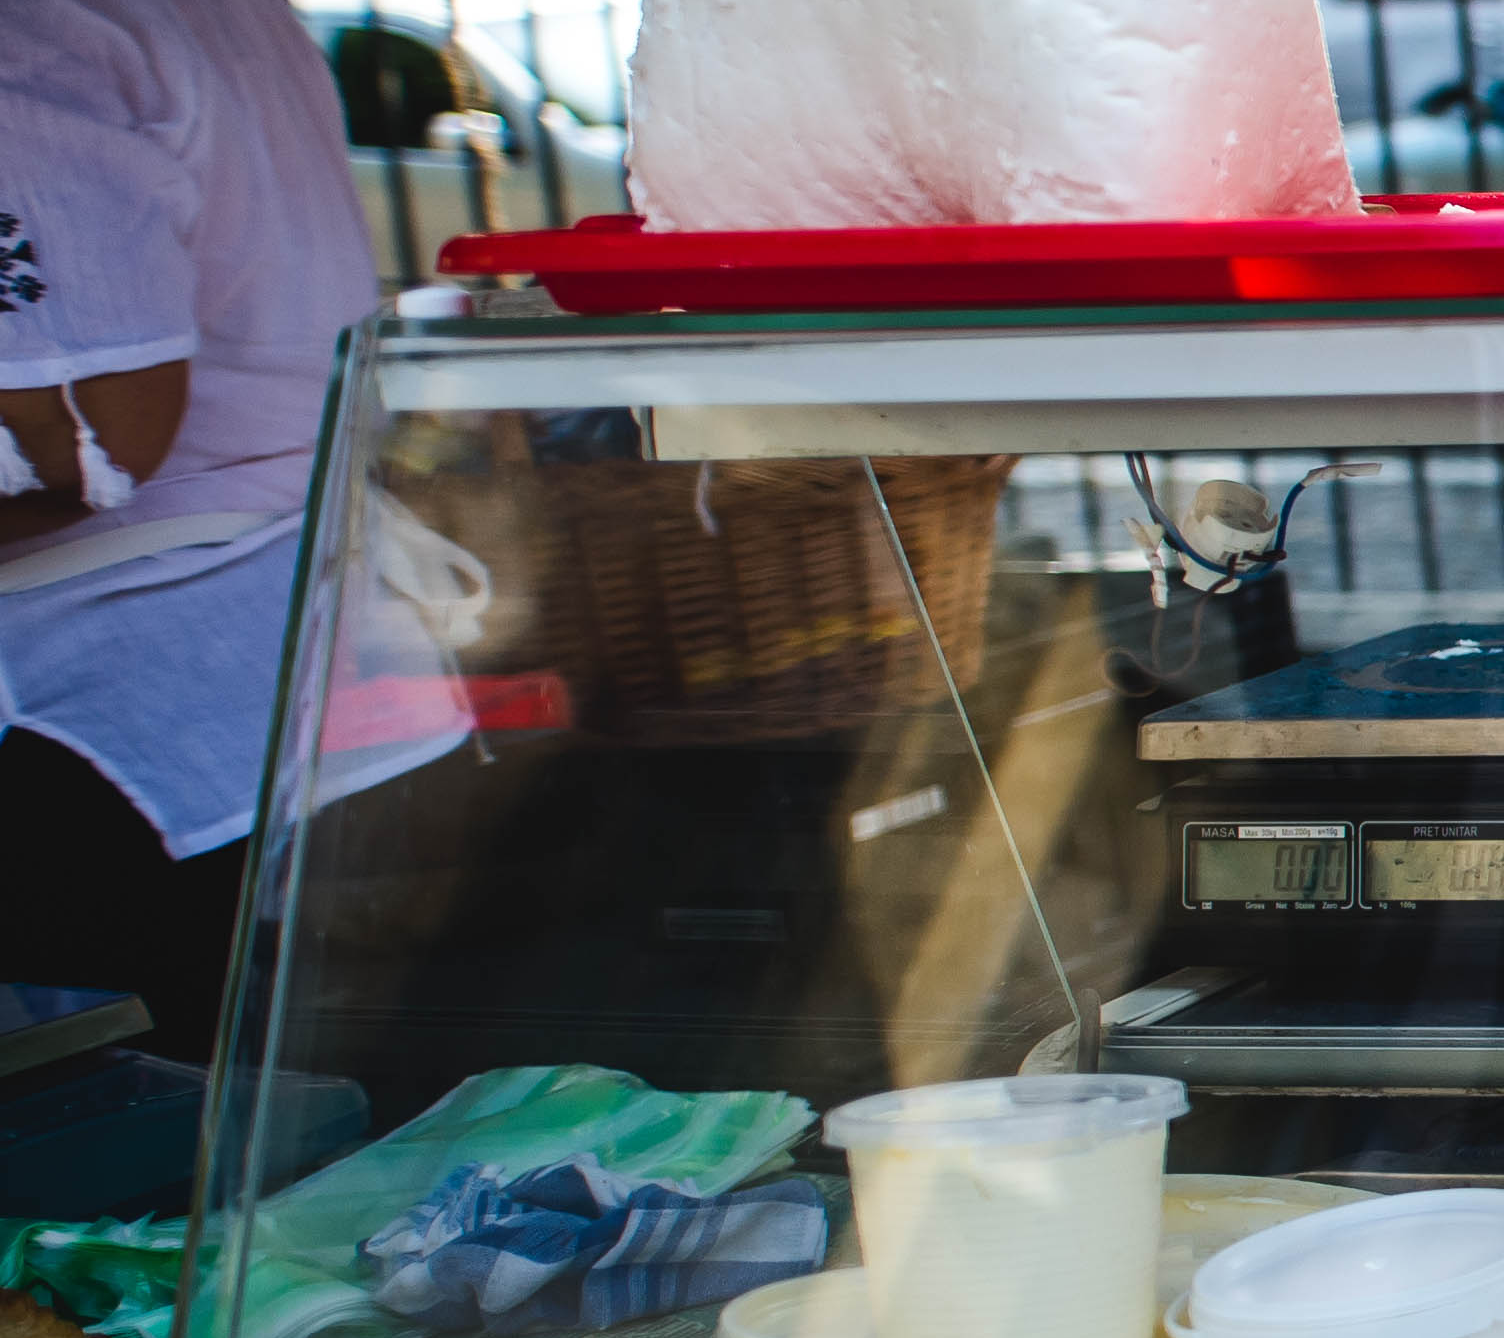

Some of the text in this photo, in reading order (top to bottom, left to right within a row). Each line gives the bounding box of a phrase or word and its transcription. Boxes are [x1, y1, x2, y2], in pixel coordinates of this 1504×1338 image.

[1201, 827, 1236, 838] MASA
[1413, 826, 1478, 838] PRET UNITAR
